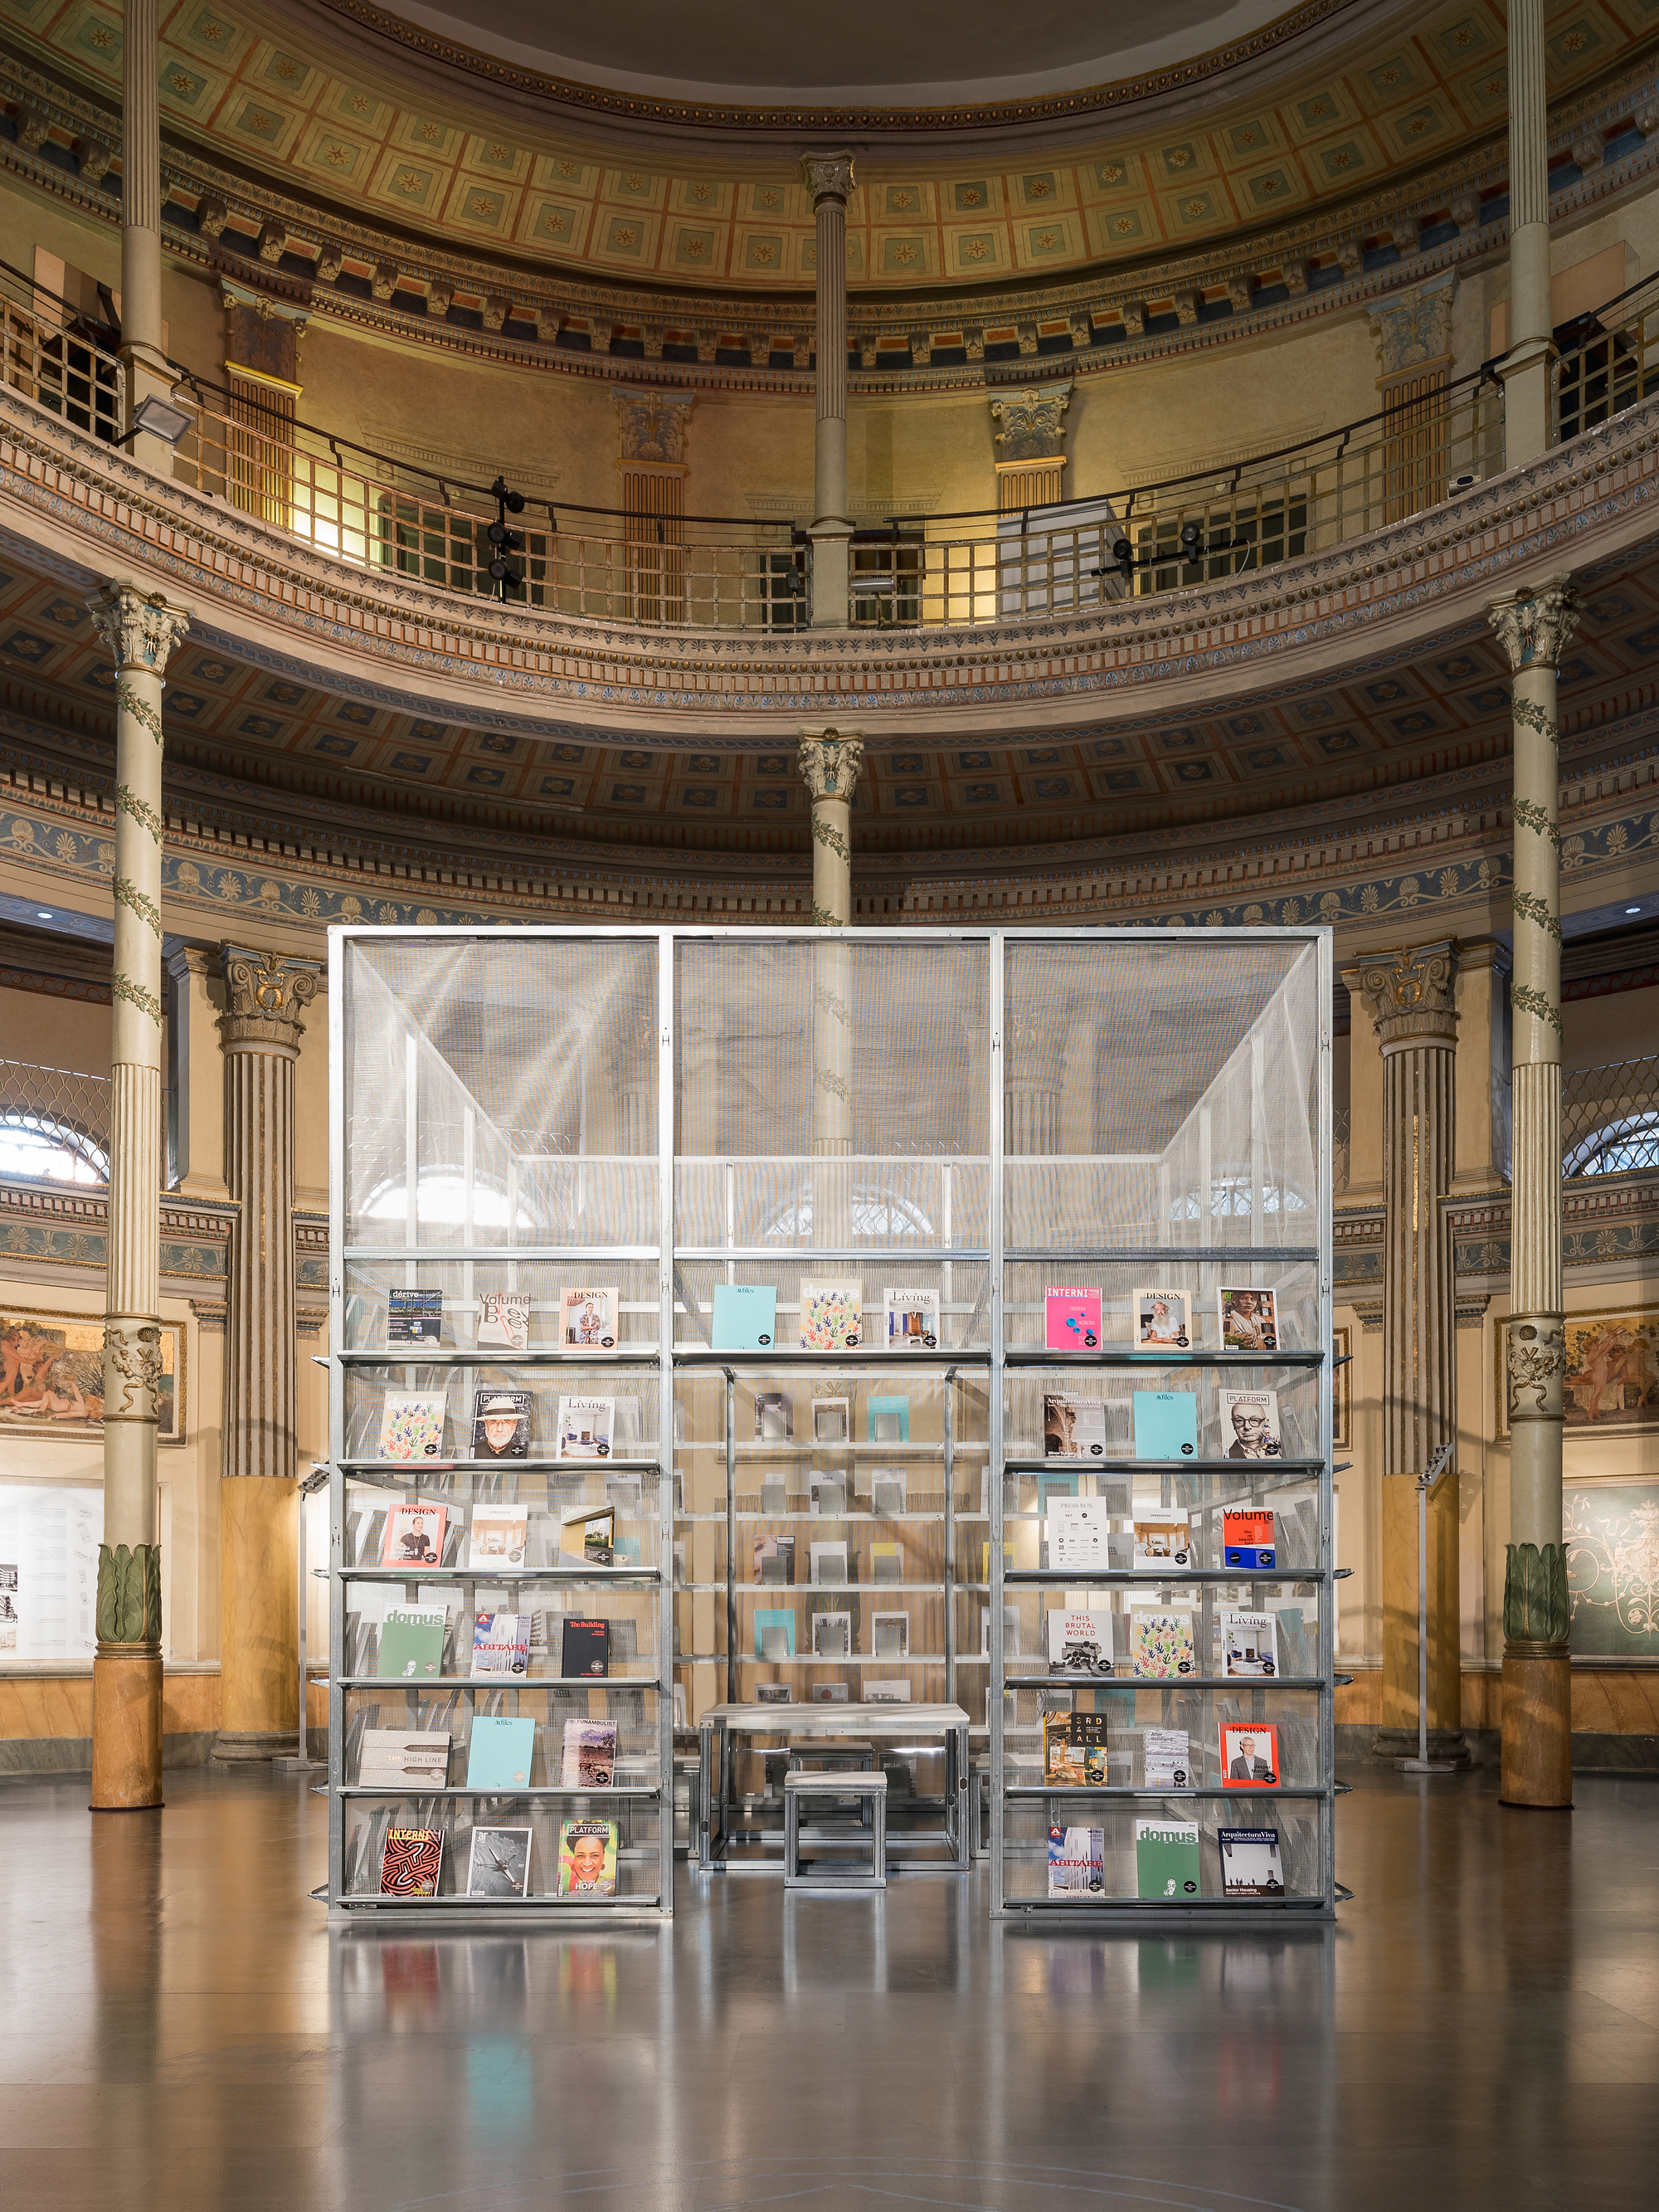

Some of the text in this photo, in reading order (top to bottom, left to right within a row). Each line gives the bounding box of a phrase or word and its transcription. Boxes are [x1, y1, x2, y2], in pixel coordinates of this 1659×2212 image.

[573, 1291, 608, 1299] DESIGN
[802, 1284, 860, 1299] domus
[1047, 1288, 1088, 1297] INTERNI
[1146, 1292, 1180, 1300] DESIGN
[1224, 1291, 1233, 1299] ar
[479, 1293, 531, 1305] Volume
[893, 1291, 931, 1304] Living
[386, 1396, 444, 1411] domus
[1229, 1395, 1267, 1403] PLATFORM
[568, 1399, 606, 1412] Living
[401, 1508, 436, 1516] DESIGN
[565, 1505, 591, 1513] dérive
[1223, 1508, 1273, 1521] Volume
[387, 1610, 444, 1625] domus
[1133, 1610, 1190, 1625] domus
[1229, 1614, 1267, 1628] Living
[1232, 1726, 1267, 1734] DESIGN
[388, 1829, 430, 1839] INTERNI
[478, 1831, 488, 1839] ar
[1140, 1827, 1196, 1843] domus
[1048, 1859, 1103, 1868] ABITARE
